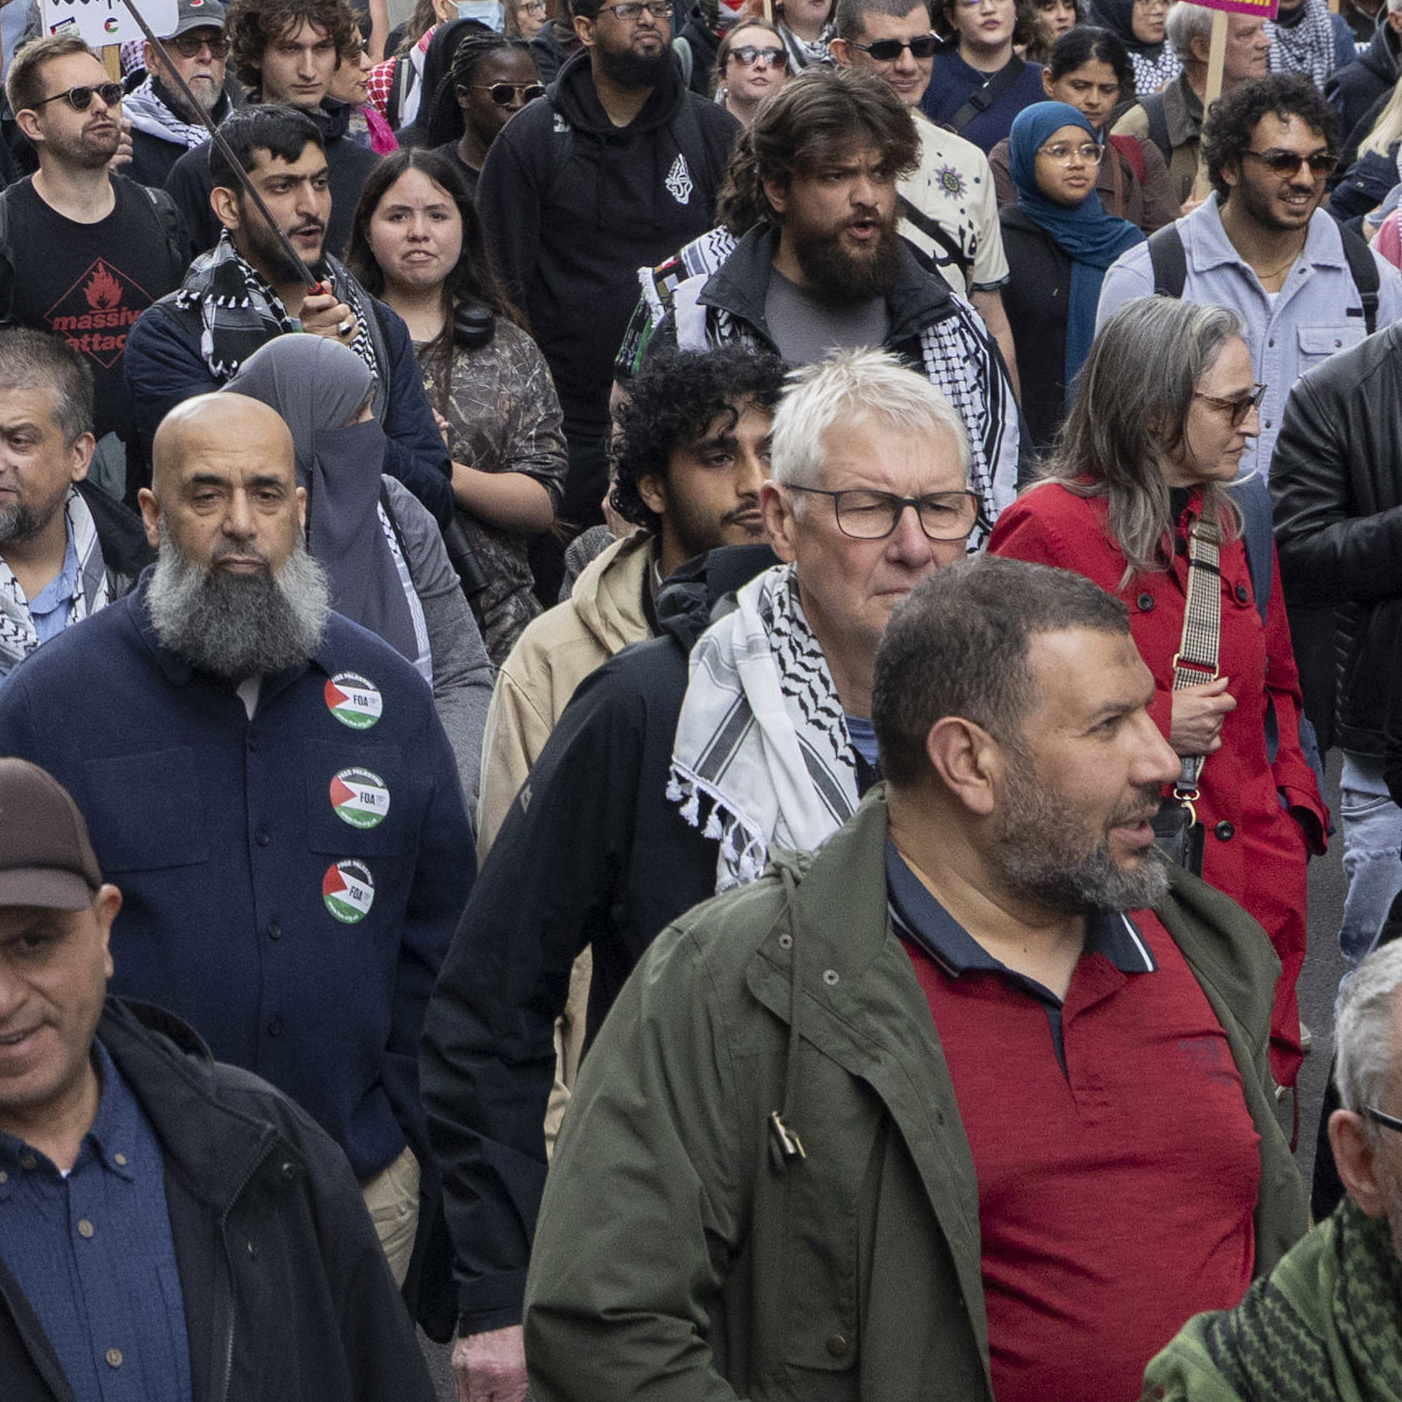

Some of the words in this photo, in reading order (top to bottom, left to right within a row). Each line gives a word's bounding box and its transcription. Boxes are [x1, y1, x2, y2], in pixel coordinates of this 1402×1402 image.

[353, 694, 369, 707] FOA
[359, 792, 376, 806] FOA
[349, 886, 364, 901] FOA
